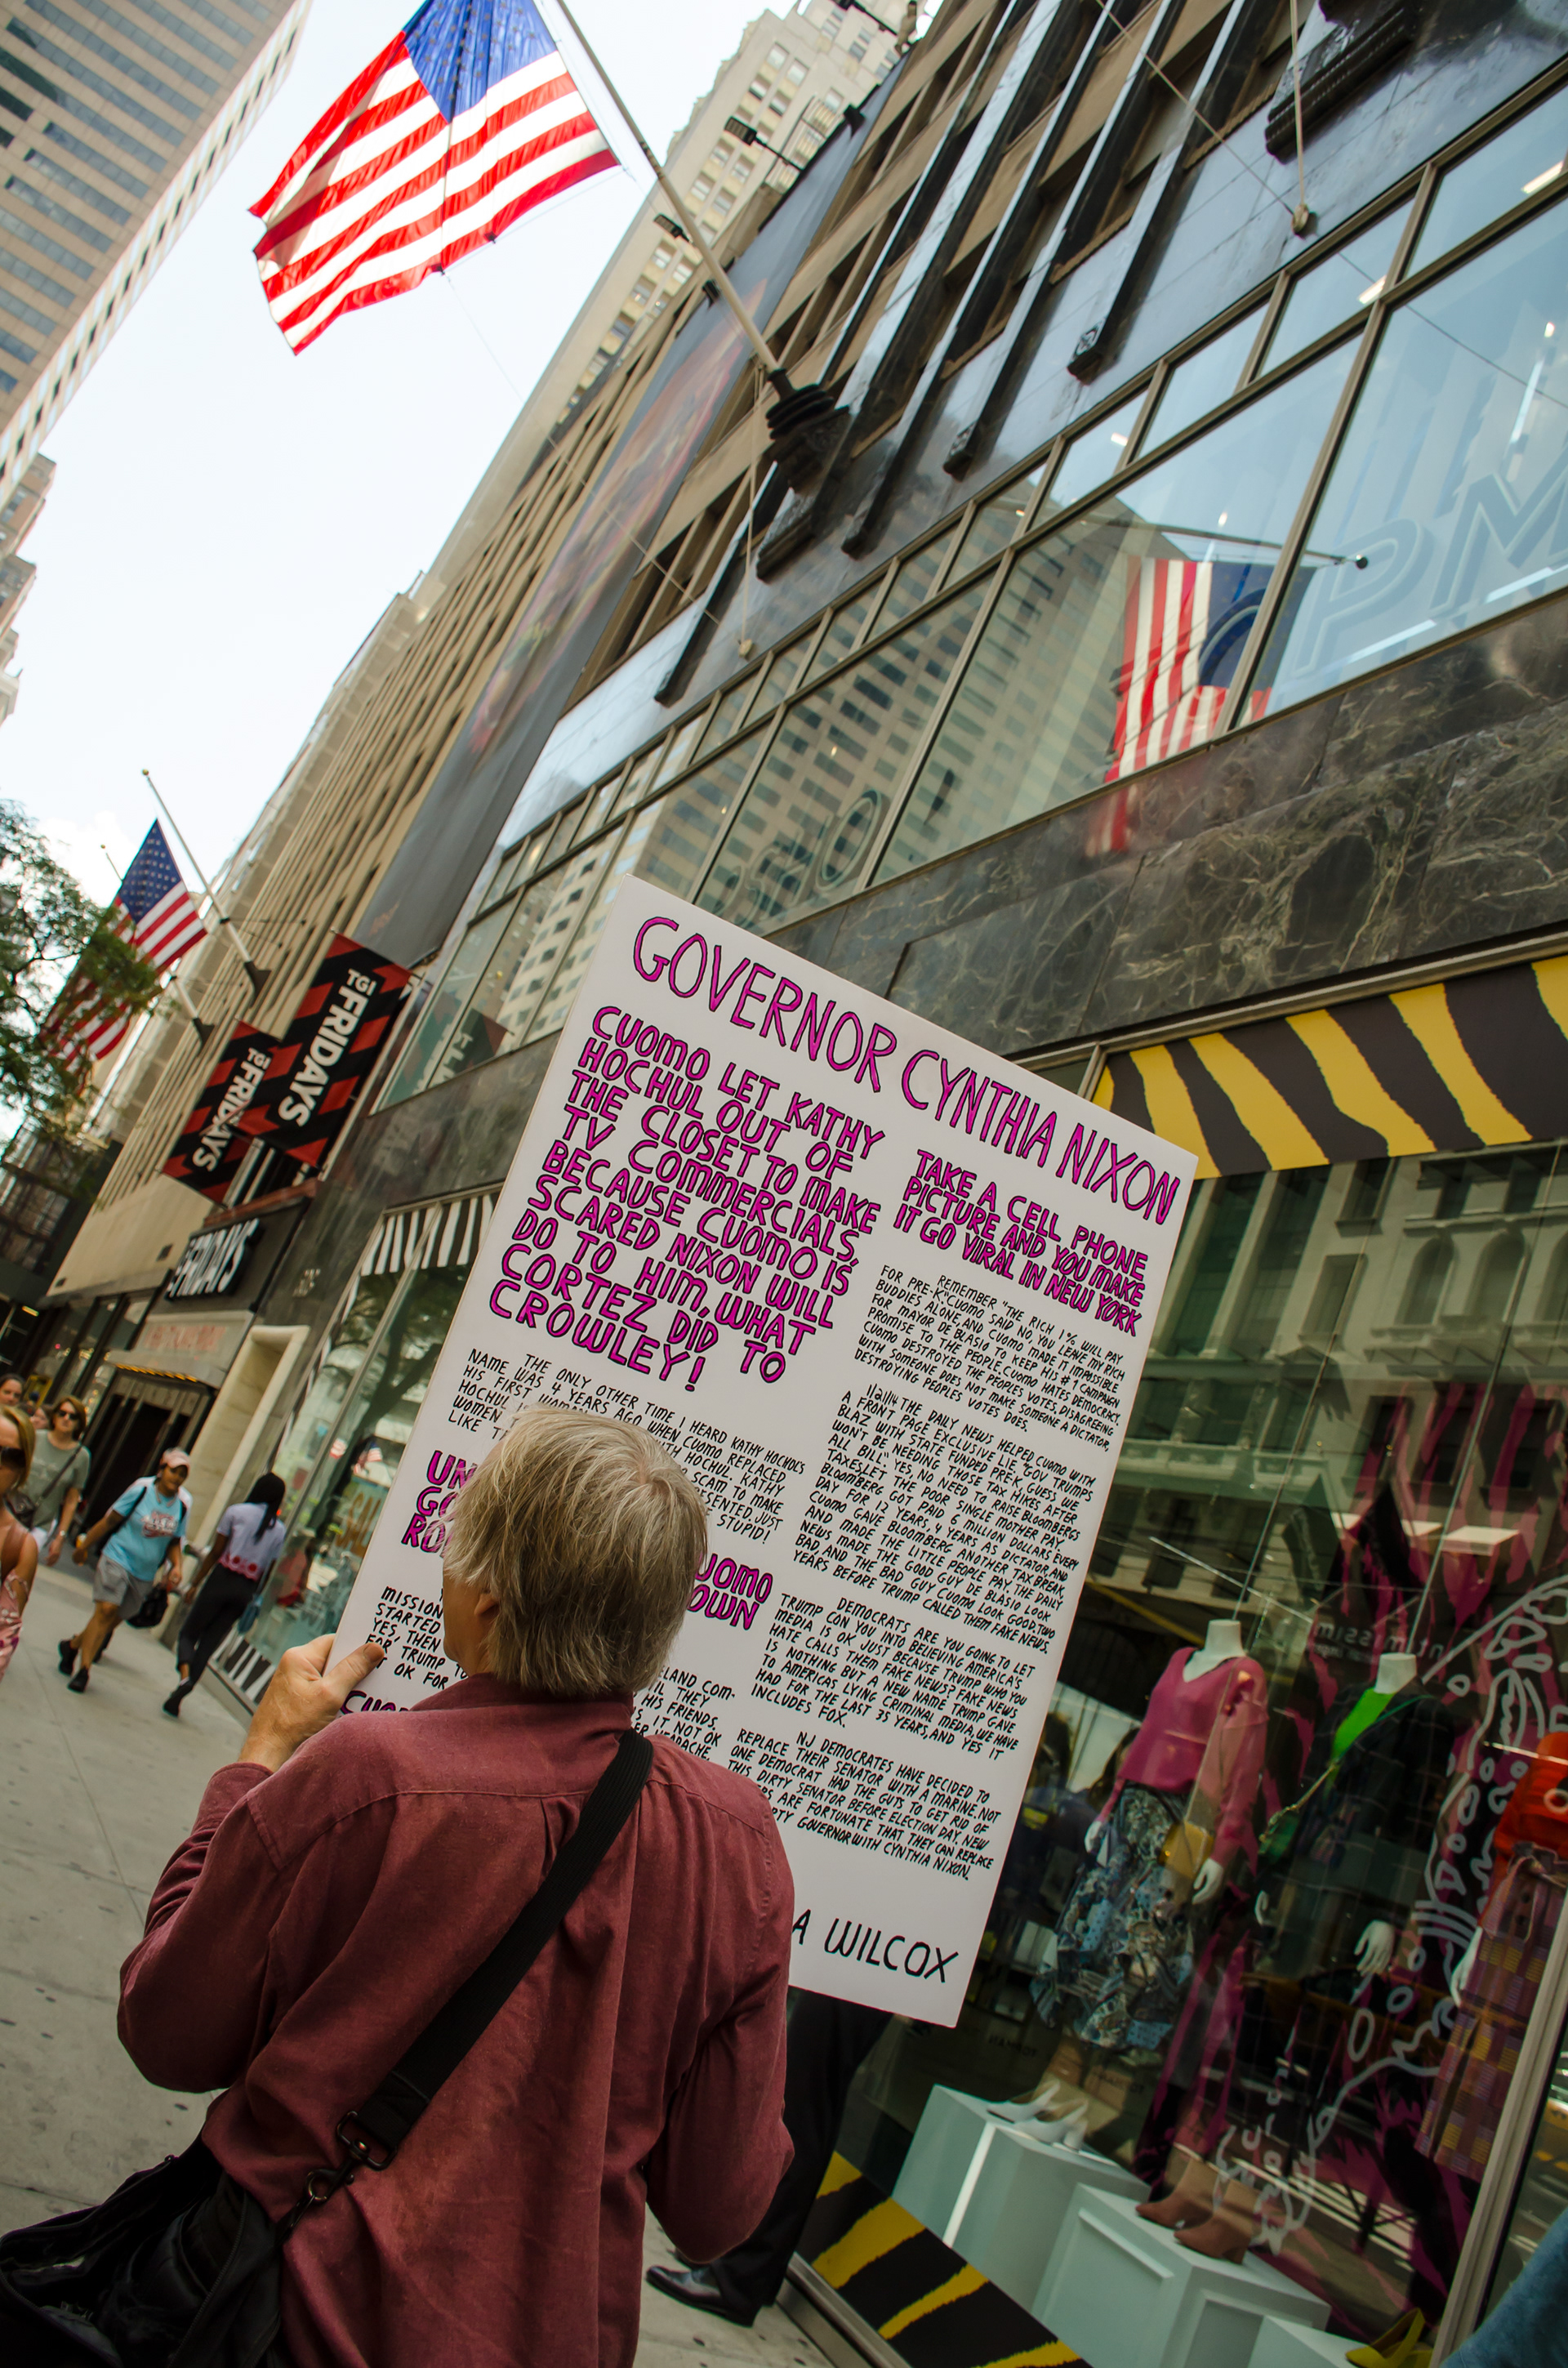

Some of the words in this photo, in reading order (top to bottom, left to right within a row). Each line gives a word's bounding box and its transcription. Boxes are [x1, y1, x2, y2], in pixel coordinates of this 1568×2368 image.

[347, 968, 376, 997] TGI
[247, 1047, 272, 1069] TGI
[278, 985, 369, 1127] FRIDAYS
[633, 916, 898, 1094] GOVERNOR
[901, 1049, 1058, 1169] CYNTHIA
[1054, 1122, 1181, 1226] NIXON
[191, 1060, 265, 1172] FRIDAYS
[567, 1068, 630, 1123] THE
[640, 1104, 761, 1178] CLOSET
[760, 1153, 799, 1196] TO
[799, 1175, 882, 1235] MAKE
[577, 1037, 704, 1121] HOCHUL
[715, 1099, 791, 1153] OUT
[804, 1137, 854, 1181] OF
[717, 1061, 781, 1112] LET
[783, 1091, 886, 1161] KATHY
[541, 1139, 692, 1229] BECAUSE
[820, 1259, 853, 1296] IS
[562, 1103, 617, 1152] TV
[627, 1139, 860, 1268] COMMERCIALS,
[911, 1148, 978, 1199] TAKE
[976, 1181, 997, 1213] A
[1006, 1195, 1062, 1243] CELL
[1070, 1224, 1148, 1282] PHONE
[511, 1207, 559, 1251] DO
[572, 1230, 617, 1275] TO
[527, 1173, 661, 1251] SCARED
[664, 1232, 763, 1295] NIXON
[764, 1273, 834, 1330] WILL
[893, 1202, 924, 1233] IT
[919, 1216, 957, 1251] GO
[961, 1232, 1016, 1281] VIRAL
[1018, 1259, 1048, 1291] IN
[1043, 1272, 1096, 1313] NEW
[1094, 1292, 1143, 1337] YORK
[902, 1175, 1001, 1242] PICTURE
[999, 1223, 1048, 1259] AND
[1051, 1244, 1093, 1282] YOU
[1087, 1264, 1146, 1308] MAKE
[489, 1278, 706, 1393] CROWLEY!
[501, 1242, 658, 1334] CORTEZ
[666, 1309, 719, 1353] DID
[739, 1339, 786, 1384] TO
[937, 1274, 998, 1310] REMEMBER
[1028, 1315, 1055, 1336] RICH
[1080, 1340, 1102, 1358] WILL
[1104, 1350, 1124, 1366] PAY
[524, 1353, 552, 1374] THE
[555, 1368, 592, 1389] ONLY
[595, 1385, 639, 1410] OTHER
[644, 1402, 675, 1424] TIME
[688, 1420, 728, 1444] HEARD
[730, 1436, 765, 1458] KATHY
[901, 1337, 963, 1370] DESTROYED
[965, 1364, 986, 1380] THE
[985, 1373, 1024, 1398] PEOPLES
[684, 1451, 733, 1481] HOCHUL.
[739, 1471, 786, 1498] KATHY
[841, 1390, 851, 1404] A
[856, 1396, 896, 1420] FRONT
[898, 1414, 930, 1435] PAGE
[933, 1428, 996, 1462] EXCLUSIVE
[1053, 1476, 1094, 1502] TRUMPS
[900, 1397, 923, 1417] THE
[927, 1409, 960, 1430] DAILY
[960, 1423, 995, 1445] NEWS
[996, 1438, 1035, 1463] HELPED
[1068, 1469, 1097, 1488] WITH
[691, 1471, 728, 1494] SCAM
[732, 1485, 746, 1501] TO
[750, 1493, 784, 1515] MAKE
[716, 1514, 771, 1545] STUPID!
[696, 1552, 773, 1604] UOMO
[800, 1518, 833, 1541] NEWS
[835, 1534, 872, 1555] MADE
[876, 1548, 900, 1566] THE
[904, 1559, 934, 1578] GOOD
[937, 1572, 964, 1589] GUY
[965, 1581, 983, 1596] DE
[984, 1589, 1022, 1612] BLASIO
[1023, 1604, 1051, 1622] LOOK
[853, 1507, 885, 1527] GAVE
[887, 1519, 954, 1554] BLOOMBERG
[956, 1548, 1009, 1575] ANOTHER
[1012, 1568, 1035, 1585] TAX
[372, 1617, 401, 1643] YES,
[406, 1630, 442, 1653] THEN
[375, 1602, 441, 1634] STARTED
[686, 1583, 760, 1631] OWN
[836, 1597, 911, 1634] DEMOCRATS
[913, 1626, 940, 1644] ARE
[943, 1636, 965, 1652] YOU
[964, 1645, 997, 1665] GOING
[997, 1655, 1011, 1670] TO
[1013, 1661, 1036, 1678] LET
[394, 1662, 416, 1680] OK
[401, 1645, 446, 1670] TRUMP
[675, 1686, 710, 1708] THEY
[768, 1622, 802, 1643] HATE
[805, 1636, 840, 1657] CALLS
[845, 1649, 879, 1671] THEM
[881, 1661, 913, 1682] FAKE
[913, 1673, 956, 1699] NEWS?
[956, 1688, 987, 1708] FAKE
[986, 1699, 1018, 1719] NEWS
[640, 1692, 664, 1710] HIS
[666, 1701, 719, 1731] FRIENDS.
[751, 1683, 812, 1714] INCLUDES
[817, 1705, 848, 1728] FOX.
[730, 1745, 756, 1762] ONE
[758, 1752, 823, 1782] DEMOCRAT
[827, 1775, 851, 1792] HAD
[853, 1783, 877, 1800] THE
[878, 1792, 905, 1809] GUTS
[909, 1801, 923, 1816] TO
[926, 1807, 950, 1823] GET
[949, 1814, 970, 1830] RID
[973, 1822, 990, 1835] OF
[795, 1731, 817, 1748] NJ
[819, 1738, 894, 1773] DEMOCRATES
[895, 1764, 925, 1785] HAVE
[926, 1773, 973, 1799] DECIDED
[976, 1789, 991, 1804] TO
[796, 1816, 853, 1845] GOVERNOR
[851, 1832, 883, 1851] WITH
[883, 1841, 931, 1867] CYNTHIA
[932, 1856, 971, 1880] NIXON.
[824, 1917, 960, 1983] WILCOX
